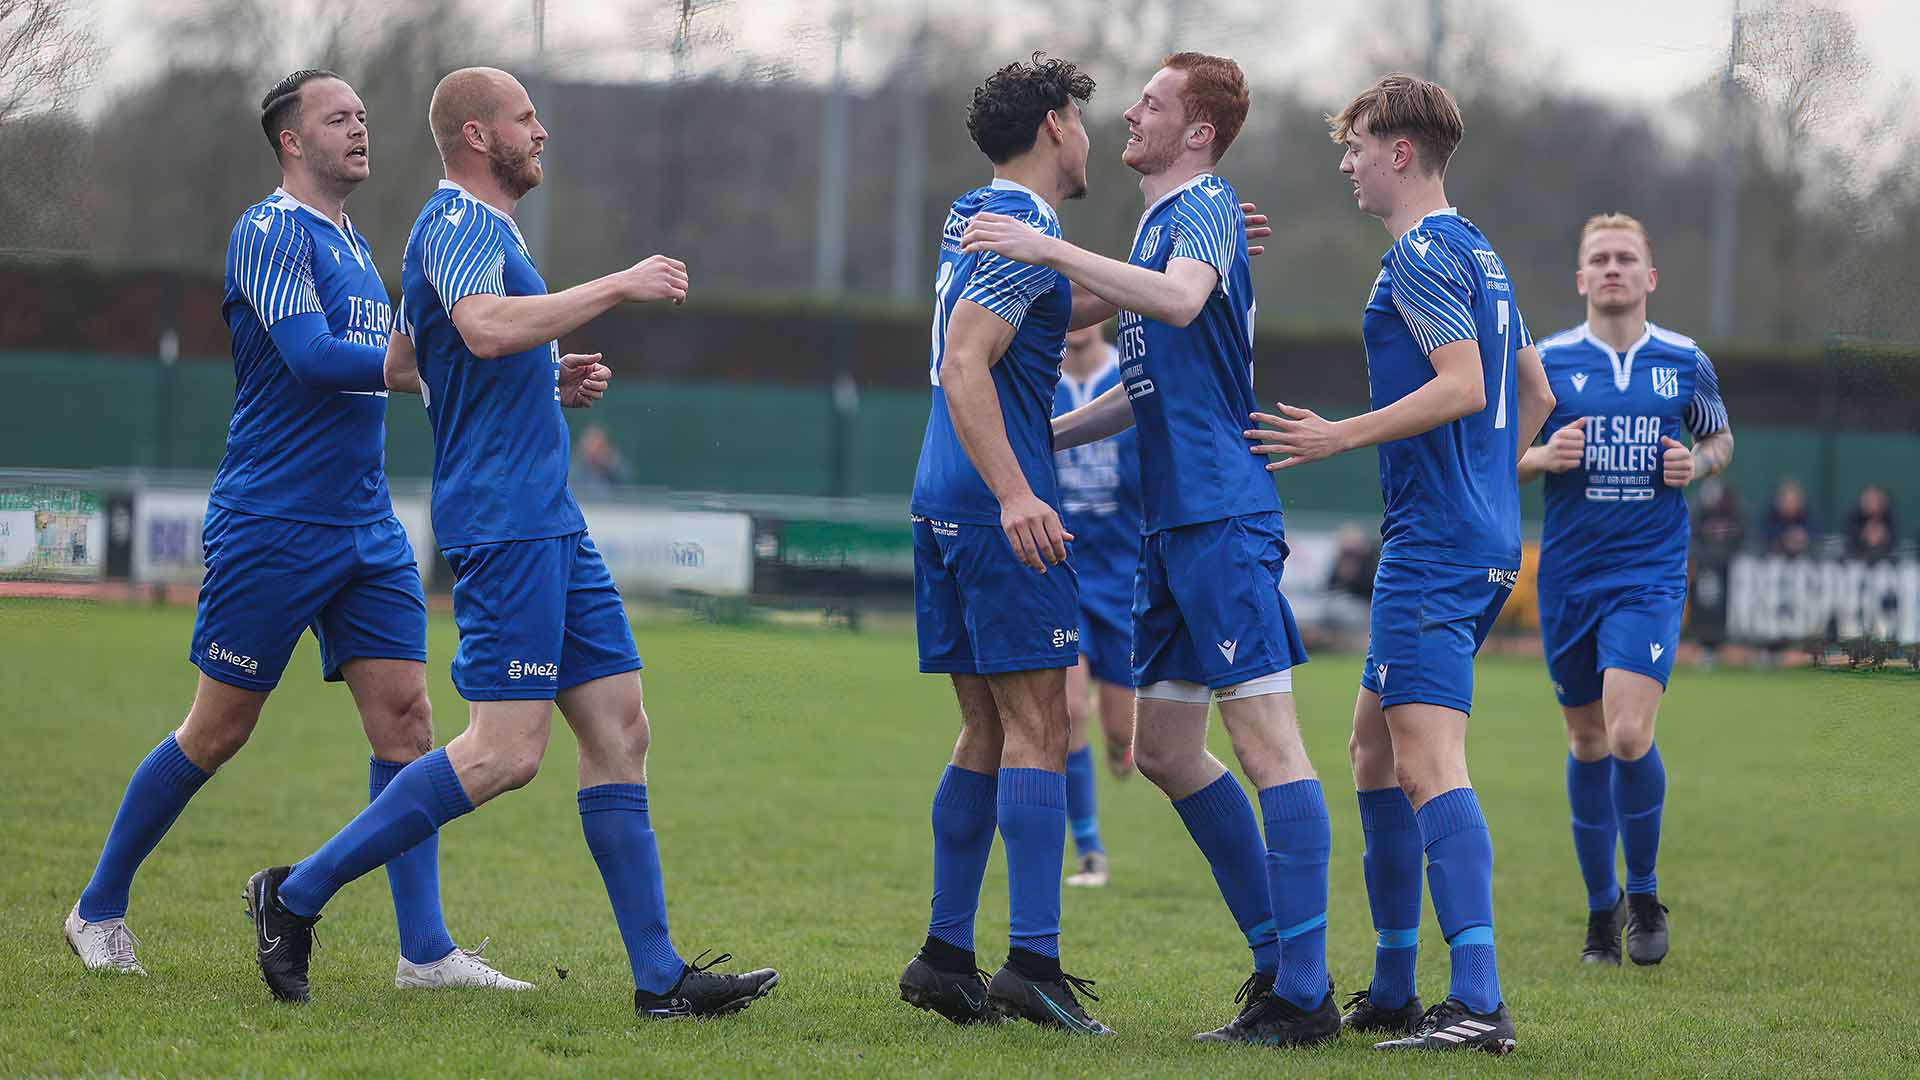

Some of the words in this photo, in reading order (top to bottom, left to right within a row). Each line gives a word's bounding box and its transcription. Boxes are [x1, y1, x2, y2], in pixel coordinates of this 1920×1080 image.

[1495, 300, 1510, 429] 7
[1584, 416, 1607, 443] TE
[1612, 416, 1660, 445] SLAA
[1585, 446, 1658, 471] PALLETS
[220, 648, 258, 670] MeZa
[524, 663, 558, 676] MeZa
